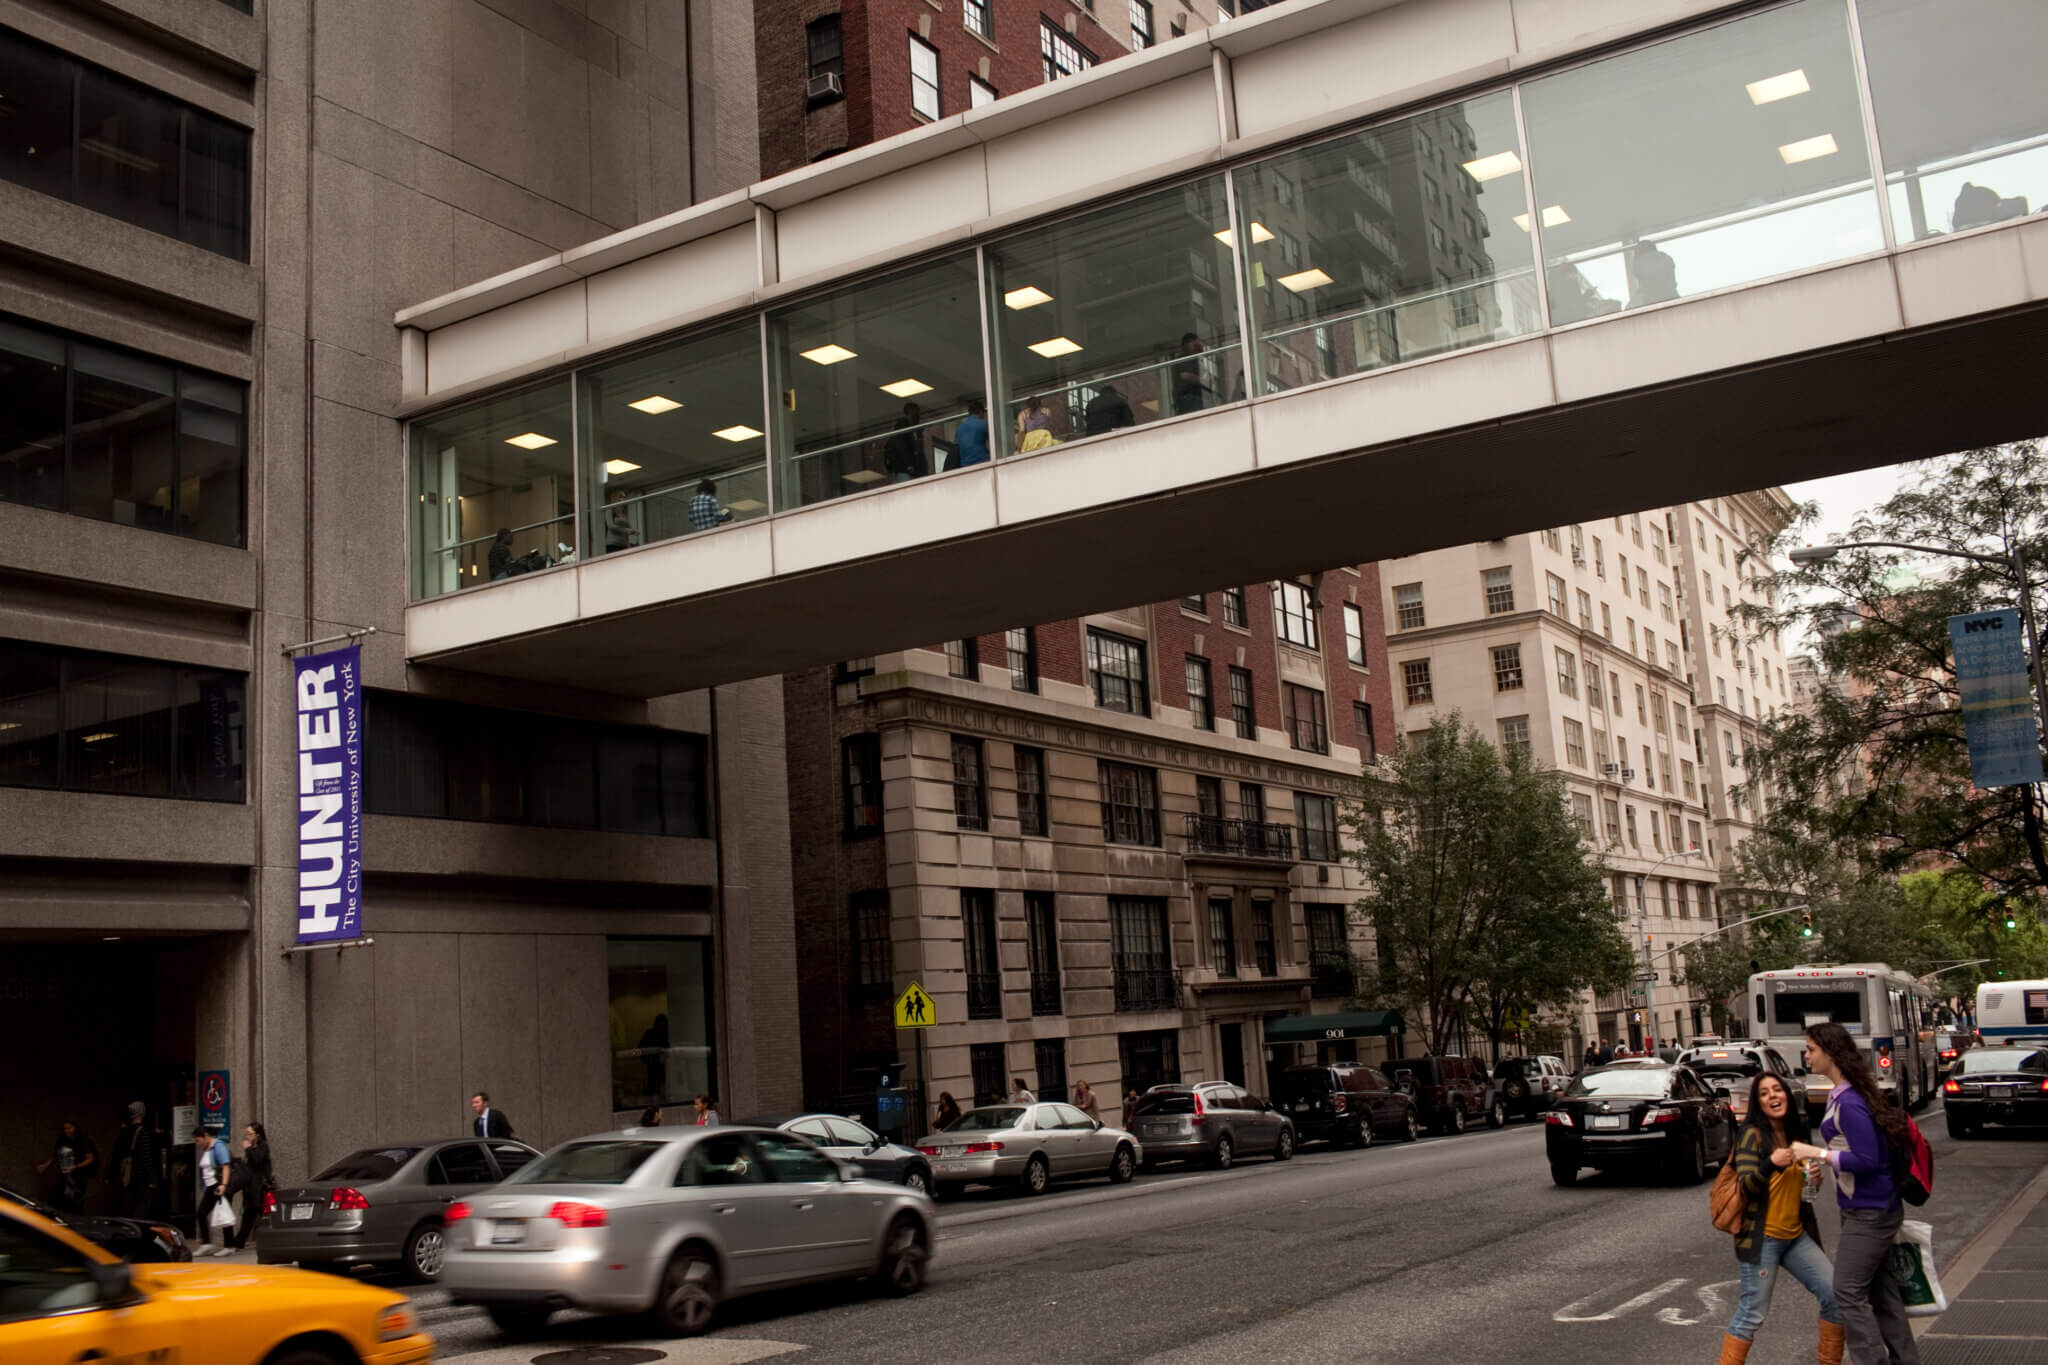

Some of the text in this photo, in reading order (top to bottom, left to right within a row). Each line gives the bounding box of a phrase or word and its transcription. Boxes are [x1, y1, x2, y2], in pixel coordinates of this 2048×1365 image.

[1964, 616, 2004, 633] NYC
[298, 664, 342, 934] HUNTER
[341, 662, 360, 930] The City University of New York
[1326, 1028, 1344, 1039] 901
[882, 1075, 889, 1086] P
